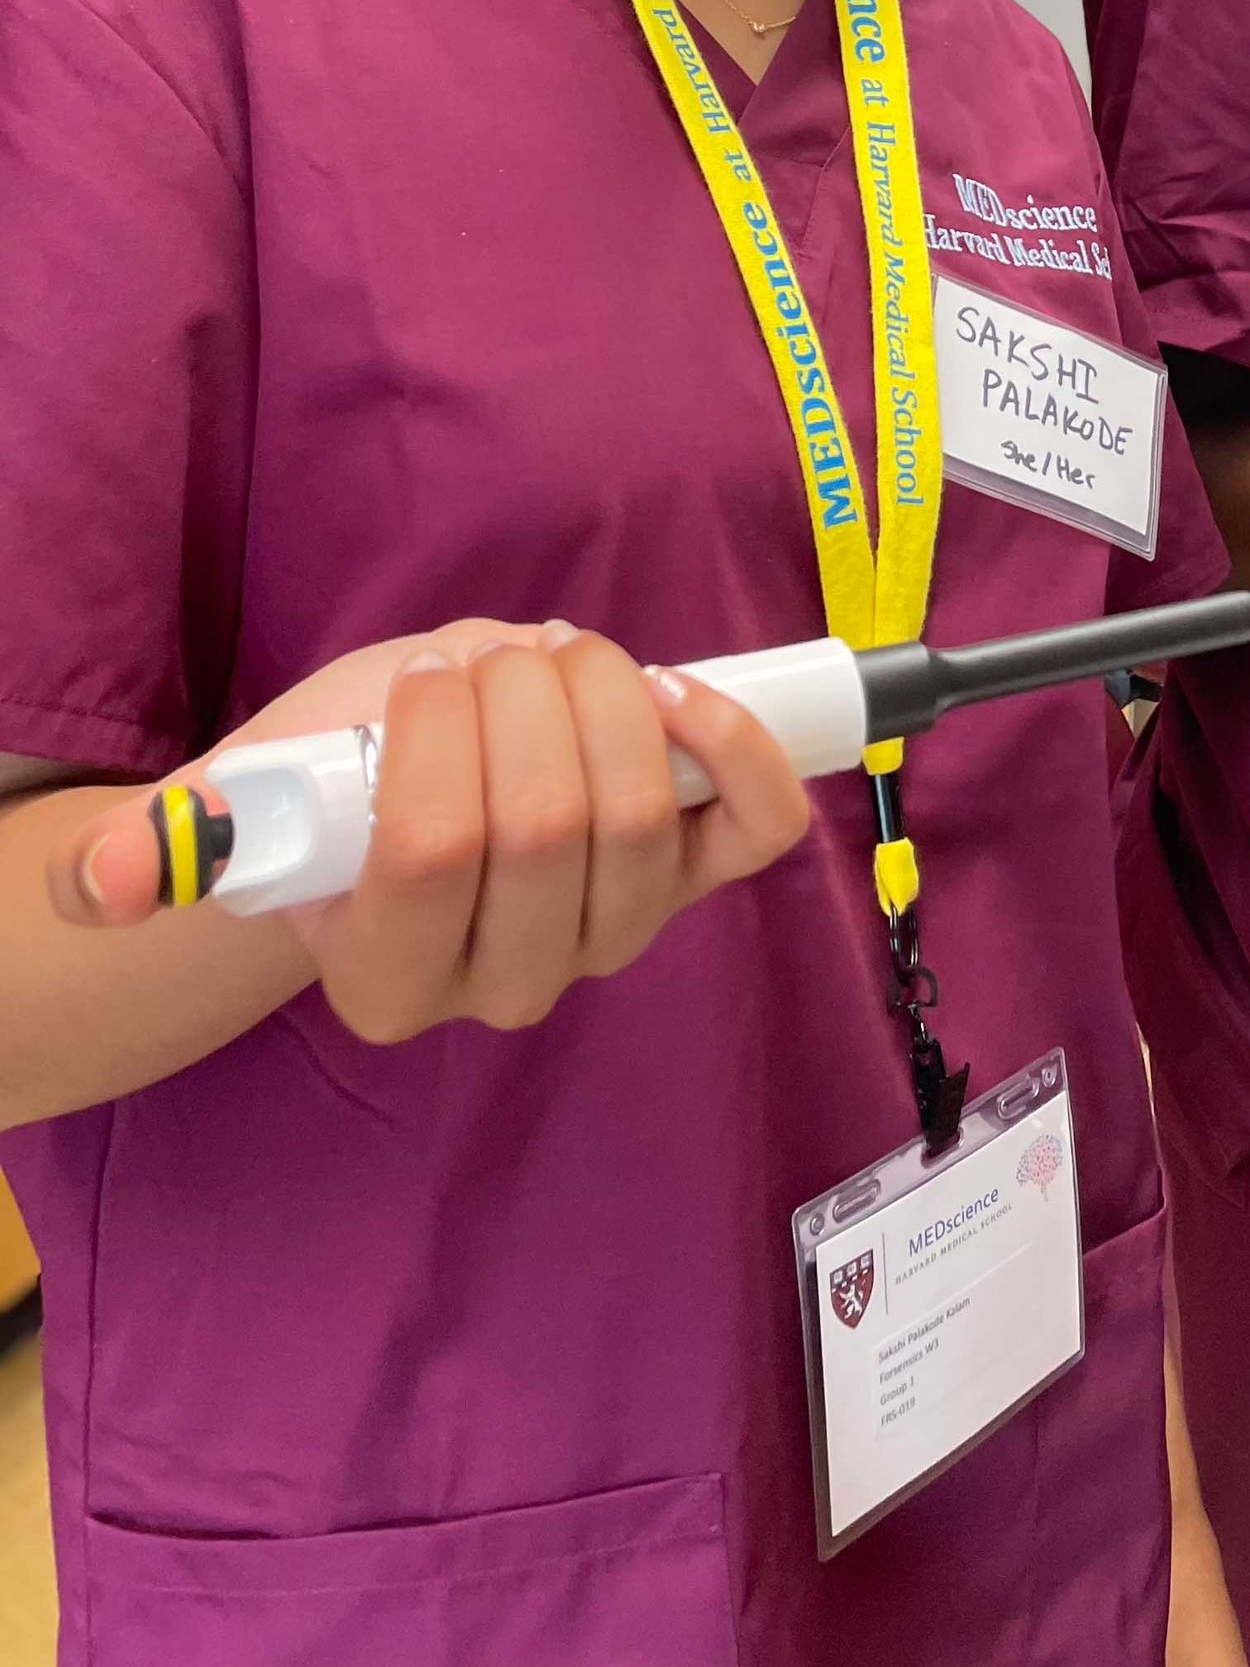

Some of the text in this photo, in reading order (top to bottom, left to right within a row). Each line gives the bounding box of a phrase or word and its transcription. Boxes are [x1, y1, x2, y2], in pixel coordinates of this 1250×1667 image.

[652, 7, 733, 135] Harvard
[861, 78, 890, 108] at
[724, 150, 752, 183] at
[866, 120, 903, 254] Harvard
[952, 172, 1098, 233] MEDscience
[922, 213, 1011, 265] Harvard
[1003, 235, 1094, 274] Medical
[880, 253, 915, 380] Medical
[956, 306, 1099, 404] SAKSHI
[743, 201, 859, 531] MEDscience
[891, 386, 925, 506] School
[982, 368, 1133, 455] PALAKODE
[895, 1203, 1013, 1285] HARVARD MEDICAL SCHOOL
[908, 1188, 999, 1256] MEDscience
[880, 1382, 908, 1407] Group
